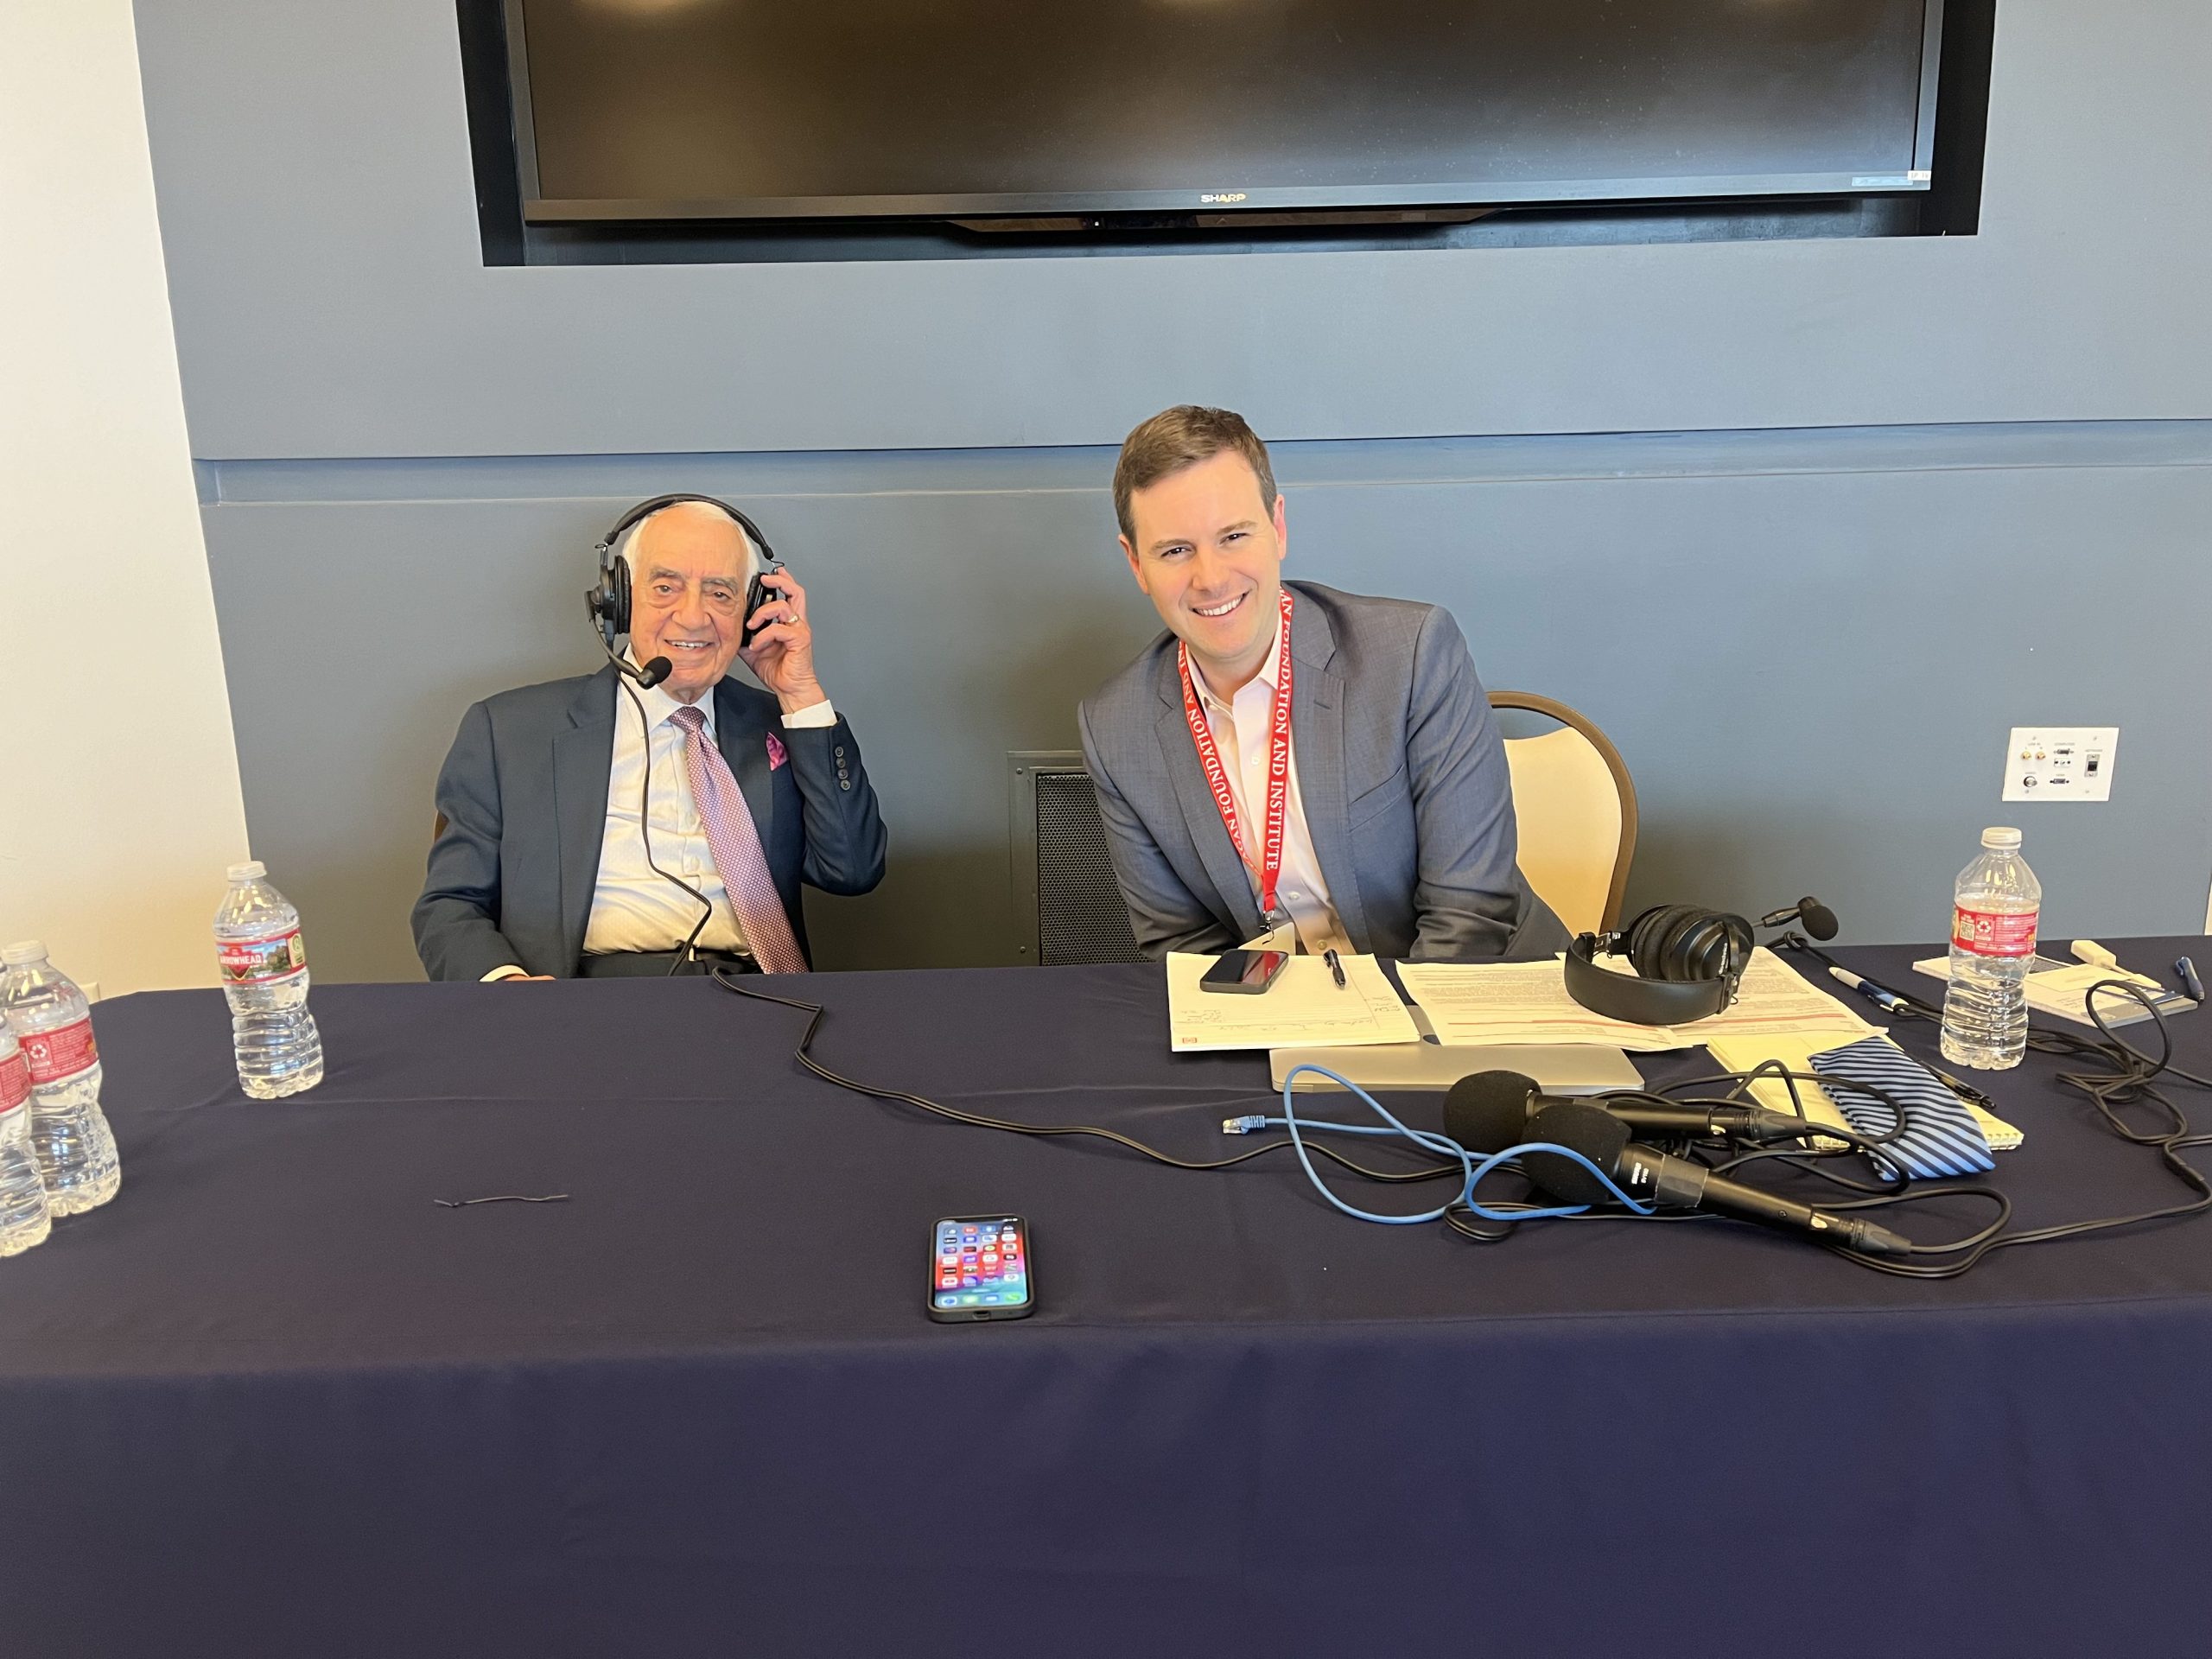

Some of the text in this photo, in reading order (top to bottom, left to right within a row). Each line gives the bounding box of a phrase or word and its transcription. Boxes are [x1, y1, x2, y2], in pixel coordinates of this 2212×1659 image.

[1201, 193, 1246, 203] SHARP
[1183, 671, 1194, 705] AND
[1274, 620, 1291, 734] FOUNDATION
[1187, 709, 1234, 816] FOUNDATION
[1272, 739, 1287, 776] AND
[1266, 780, 1284, 871] INSTITUTE
[219, 955, 262, 965] ARROWHEAD
